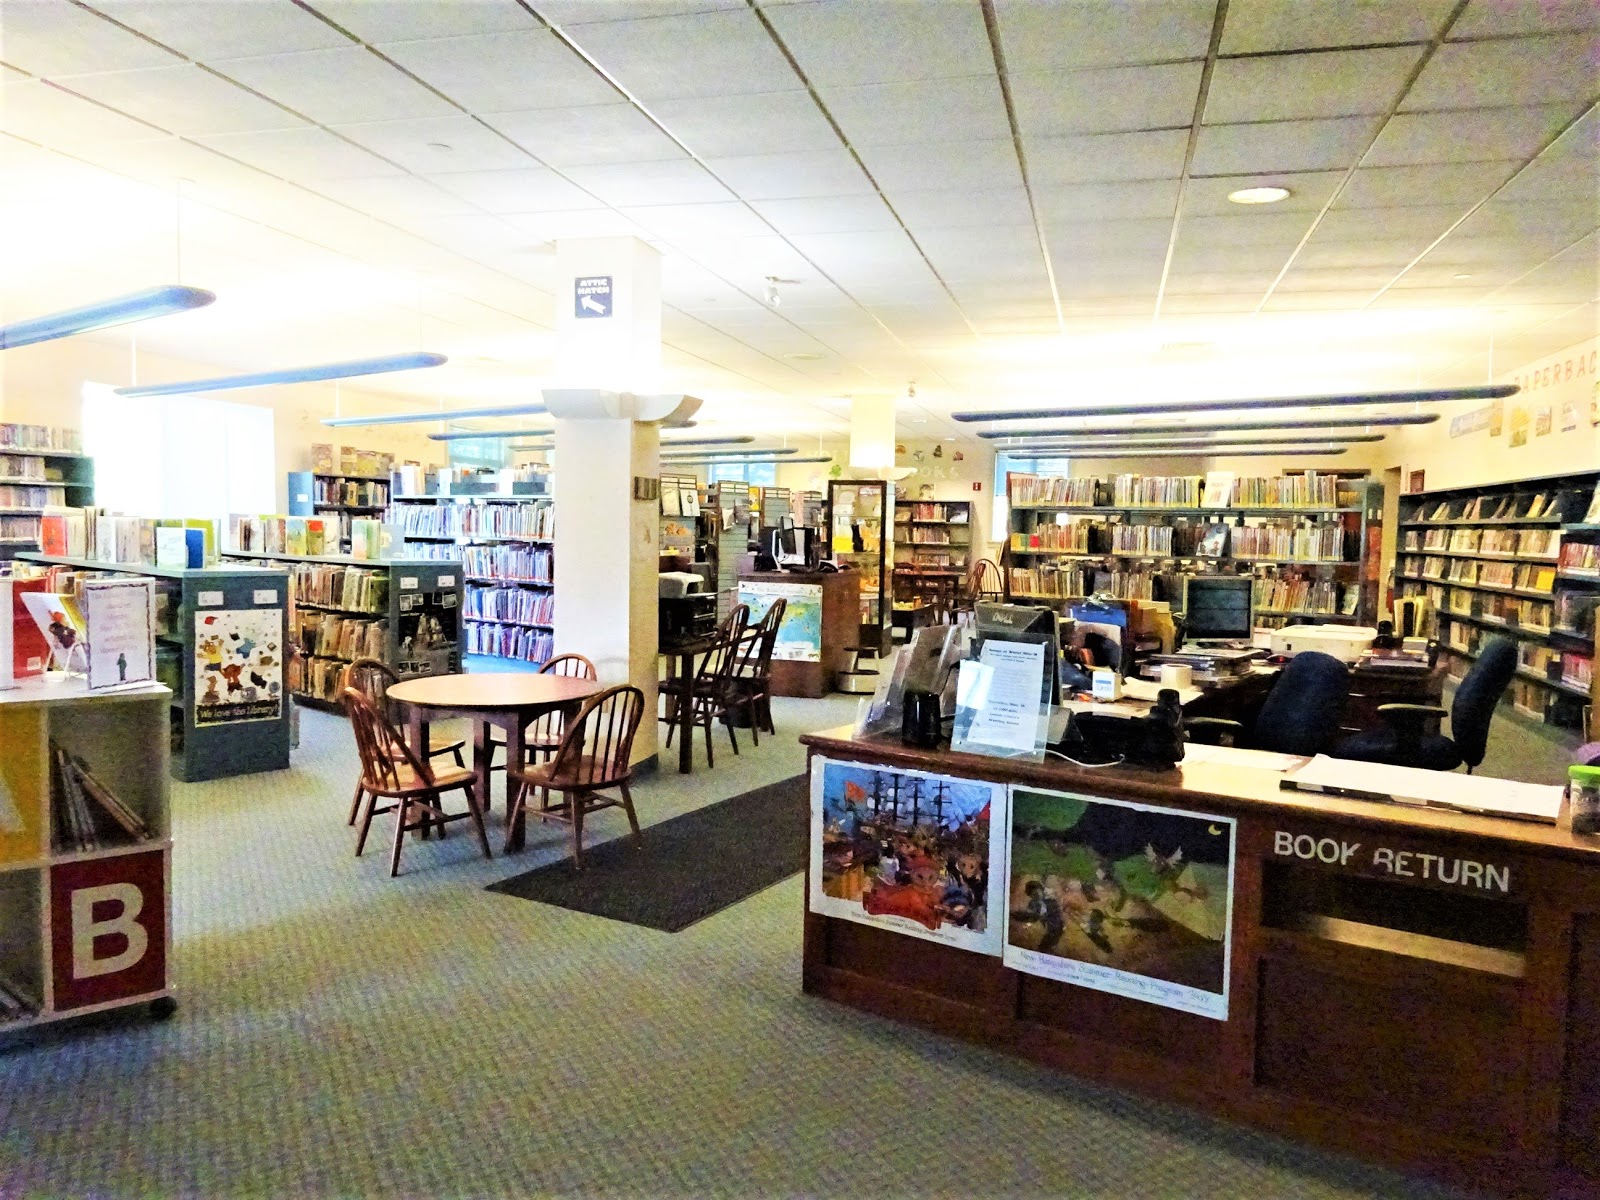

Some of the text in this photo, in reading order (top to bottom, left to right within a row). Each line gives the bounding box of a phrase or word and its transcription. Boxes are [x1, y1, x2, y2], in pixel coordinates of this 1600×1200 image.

[577, 286, 610, 294] HATCH
[580, 279, 607, 287] ATTIC
[1273, 830, 1510, 893] BOOK RETURN
[71, 882, 149, 980] B
